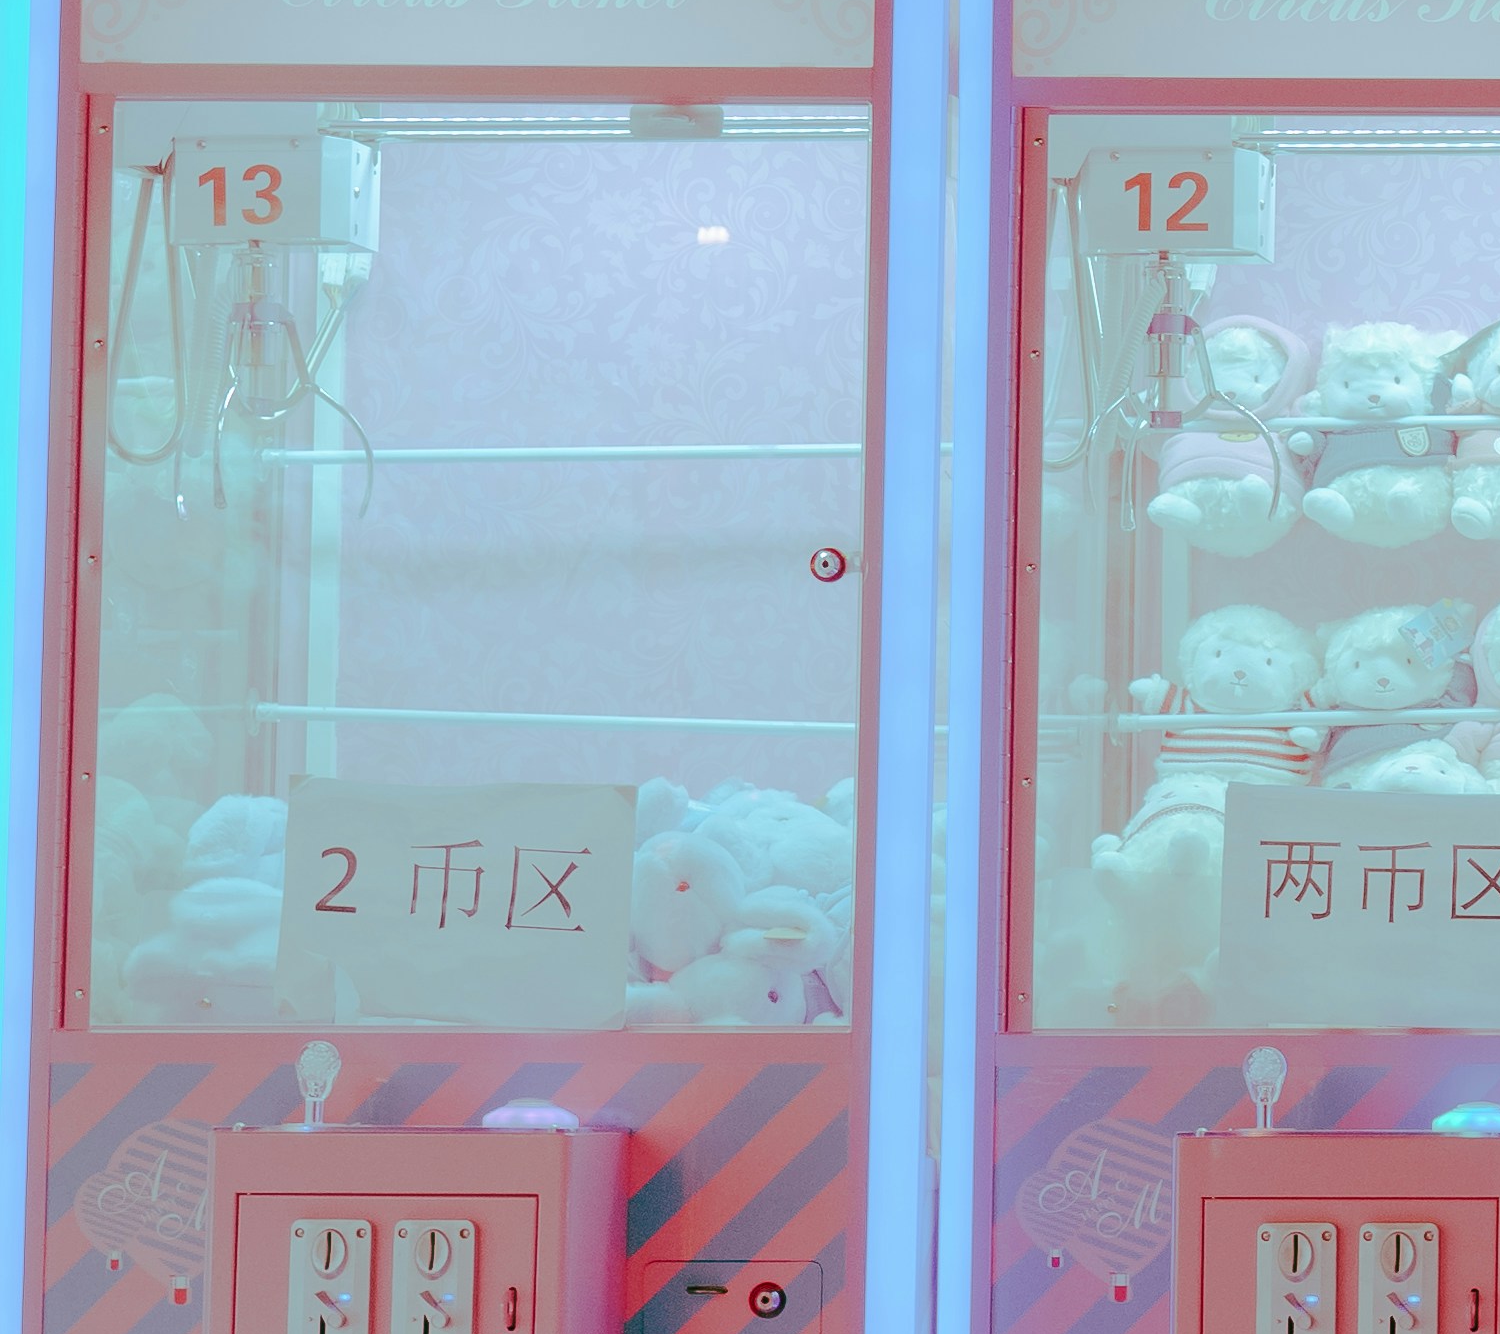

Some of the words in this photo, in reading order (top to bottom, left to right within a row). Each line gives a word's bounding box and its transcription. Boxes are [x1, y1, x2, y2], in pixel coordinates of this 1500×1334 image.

[199, 164, 284, 226] 13
[1123, 171, 1209, 232] 12
[315, 847, 358, 914] 2
[409, 839, 592, 933] 币区
